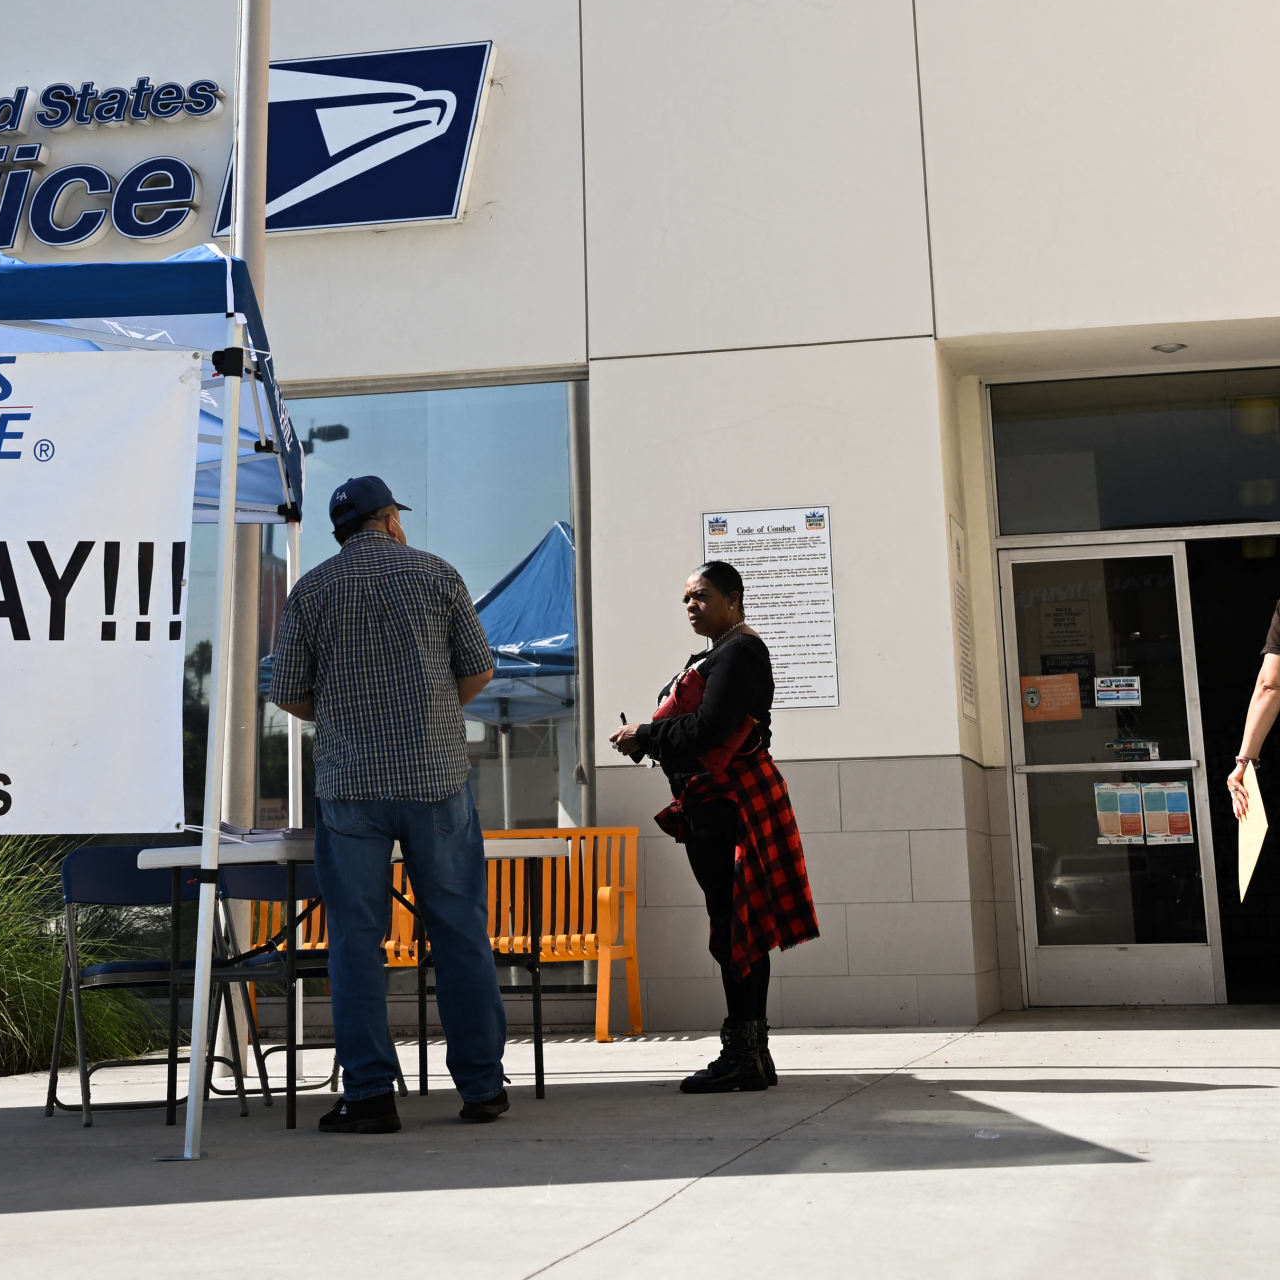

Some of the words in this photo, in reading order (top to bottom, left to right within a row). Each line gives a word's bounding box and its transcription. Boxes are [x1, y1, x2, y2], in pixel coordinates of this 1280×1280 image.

[35, 76, 219, 129] States
[336, 491, 347, 500] LA
[736, 526, 755, 535] Code
[756, 525, 765, 533] of
[767, 524, 796, 533] Conduct
